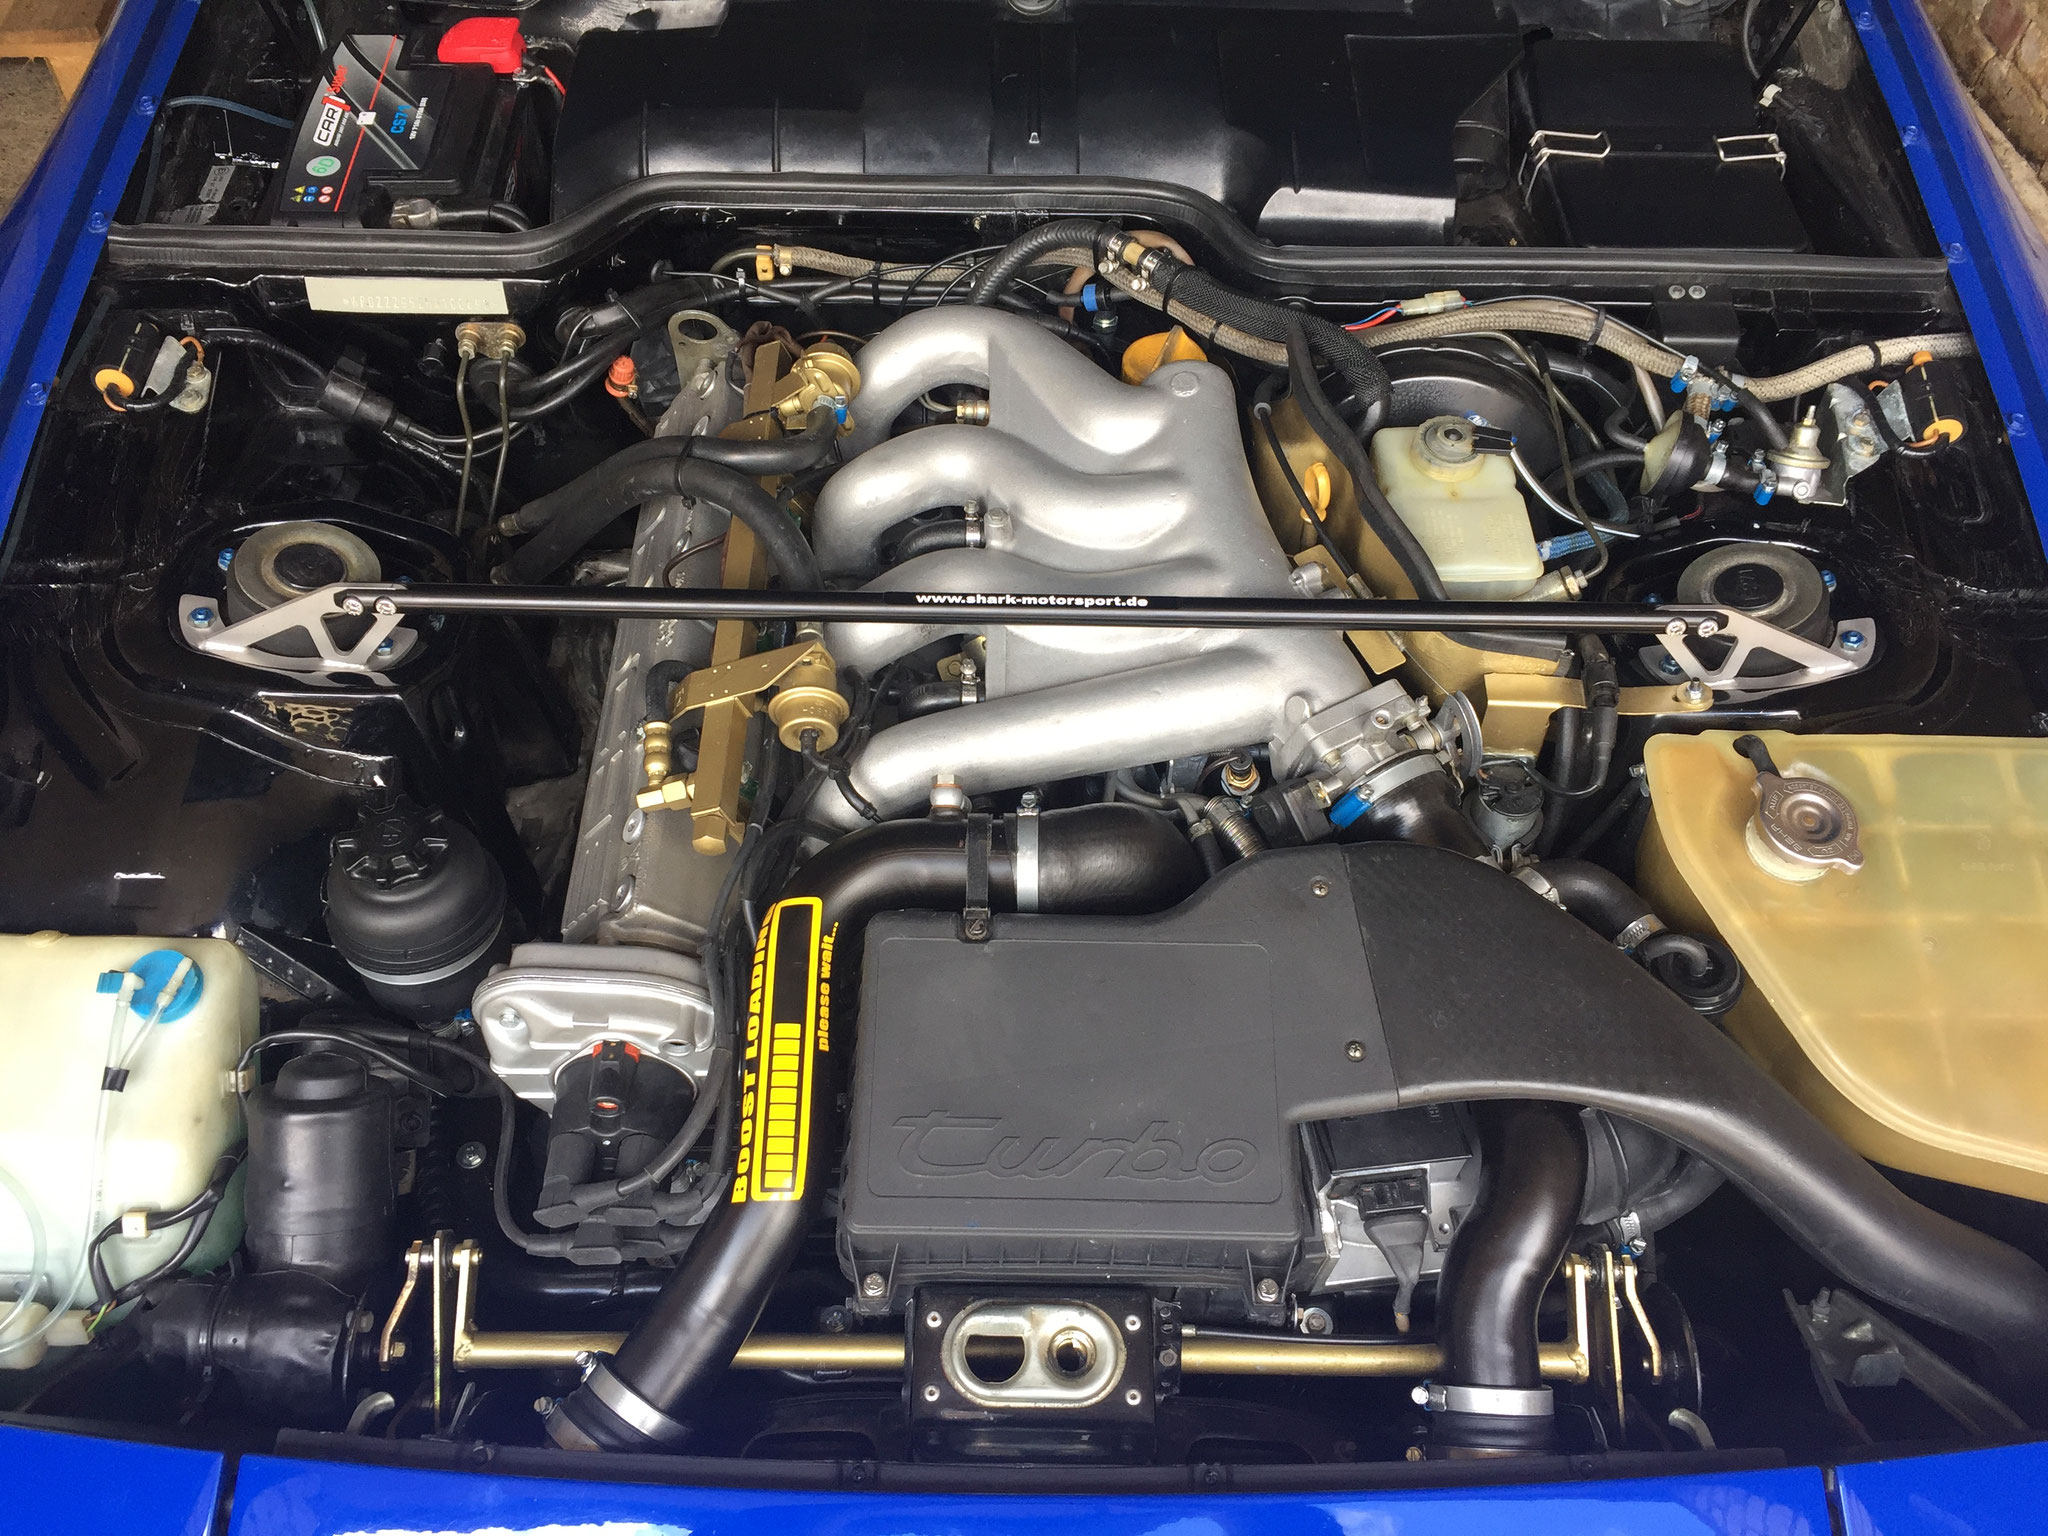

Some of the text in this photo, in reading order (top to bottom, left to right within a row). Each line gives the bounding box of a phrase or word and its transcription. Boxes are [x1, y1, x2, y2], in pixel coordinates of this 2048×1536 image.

[326, 64, 348, 94] Super
[390, 105, 412, 134] CS71
[915, 593, 1148, 608] www.shark-motorsport.de
[1769, 792, 1779, 811] AUF
[1770, 823, 1803, 852] BEHR
[817, 921, 839, 1052] please wait...
[731, 902, 777, 1204] BOOST LOADING
